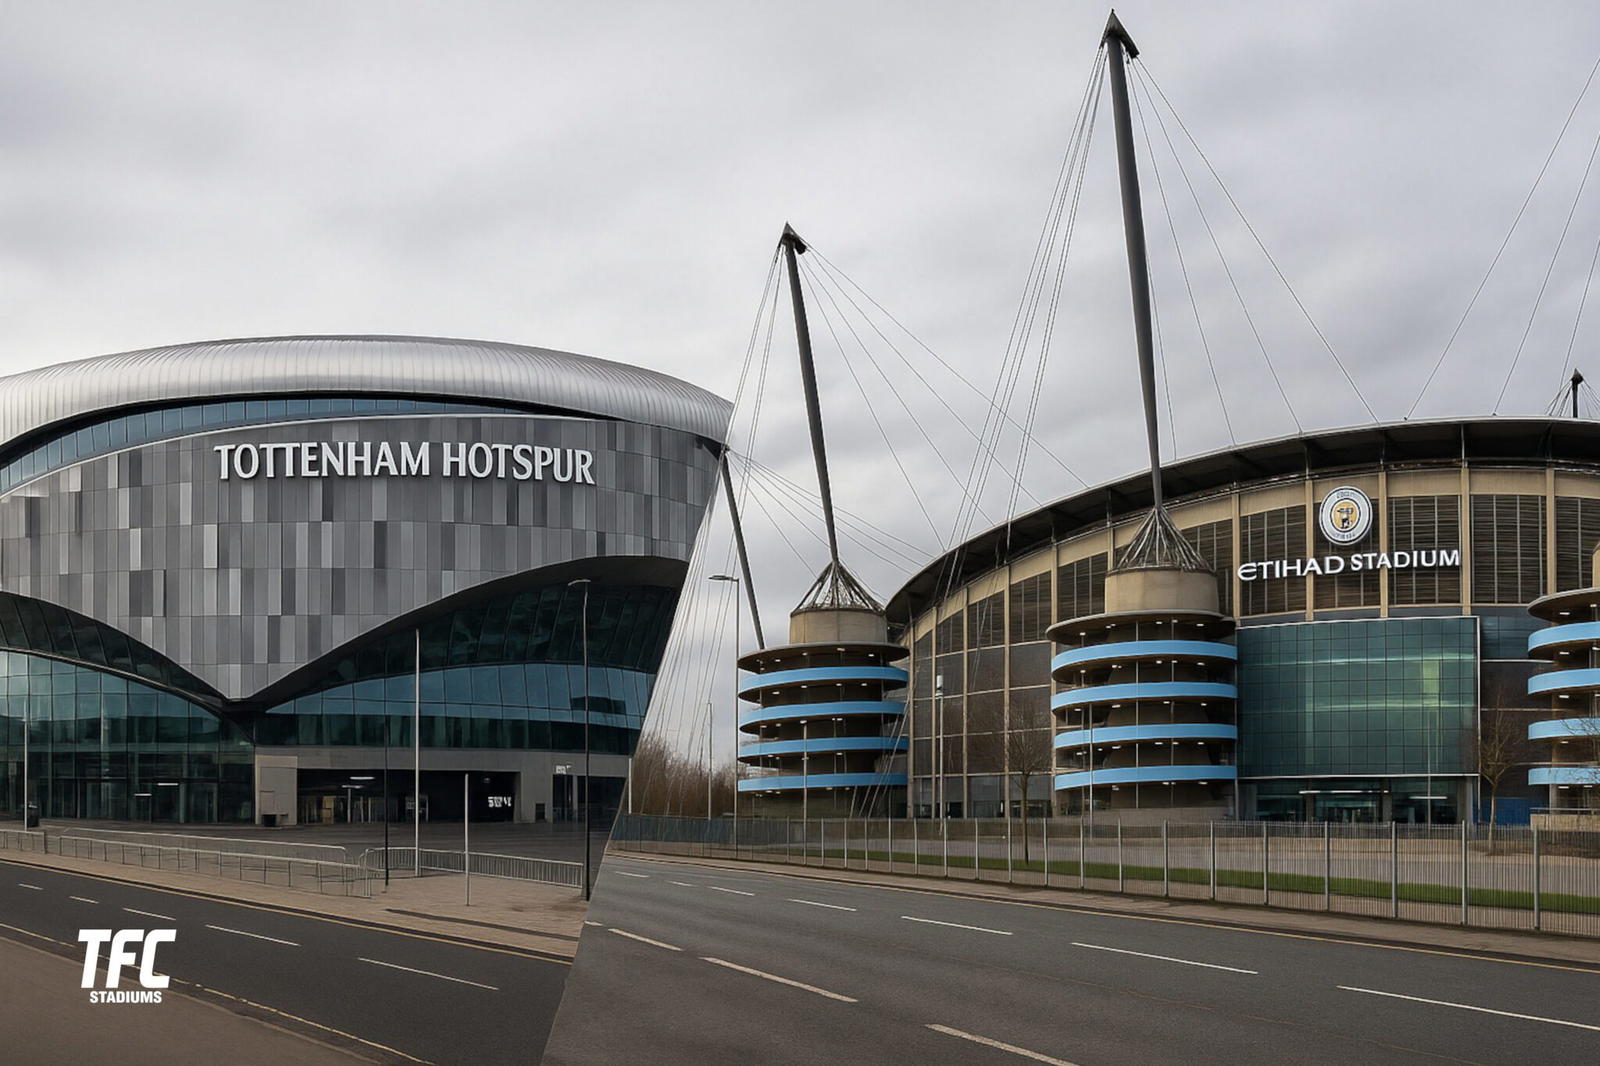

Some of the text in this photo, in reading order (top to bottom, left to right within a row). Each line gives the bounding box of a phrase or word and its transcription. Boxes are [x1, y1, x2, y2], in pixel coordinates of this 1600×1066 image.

[213, 441, 596, 485] TOTTENHAM HOTSPUR
[1237, 549, 1460, 581] ETIHAD STADIUM
